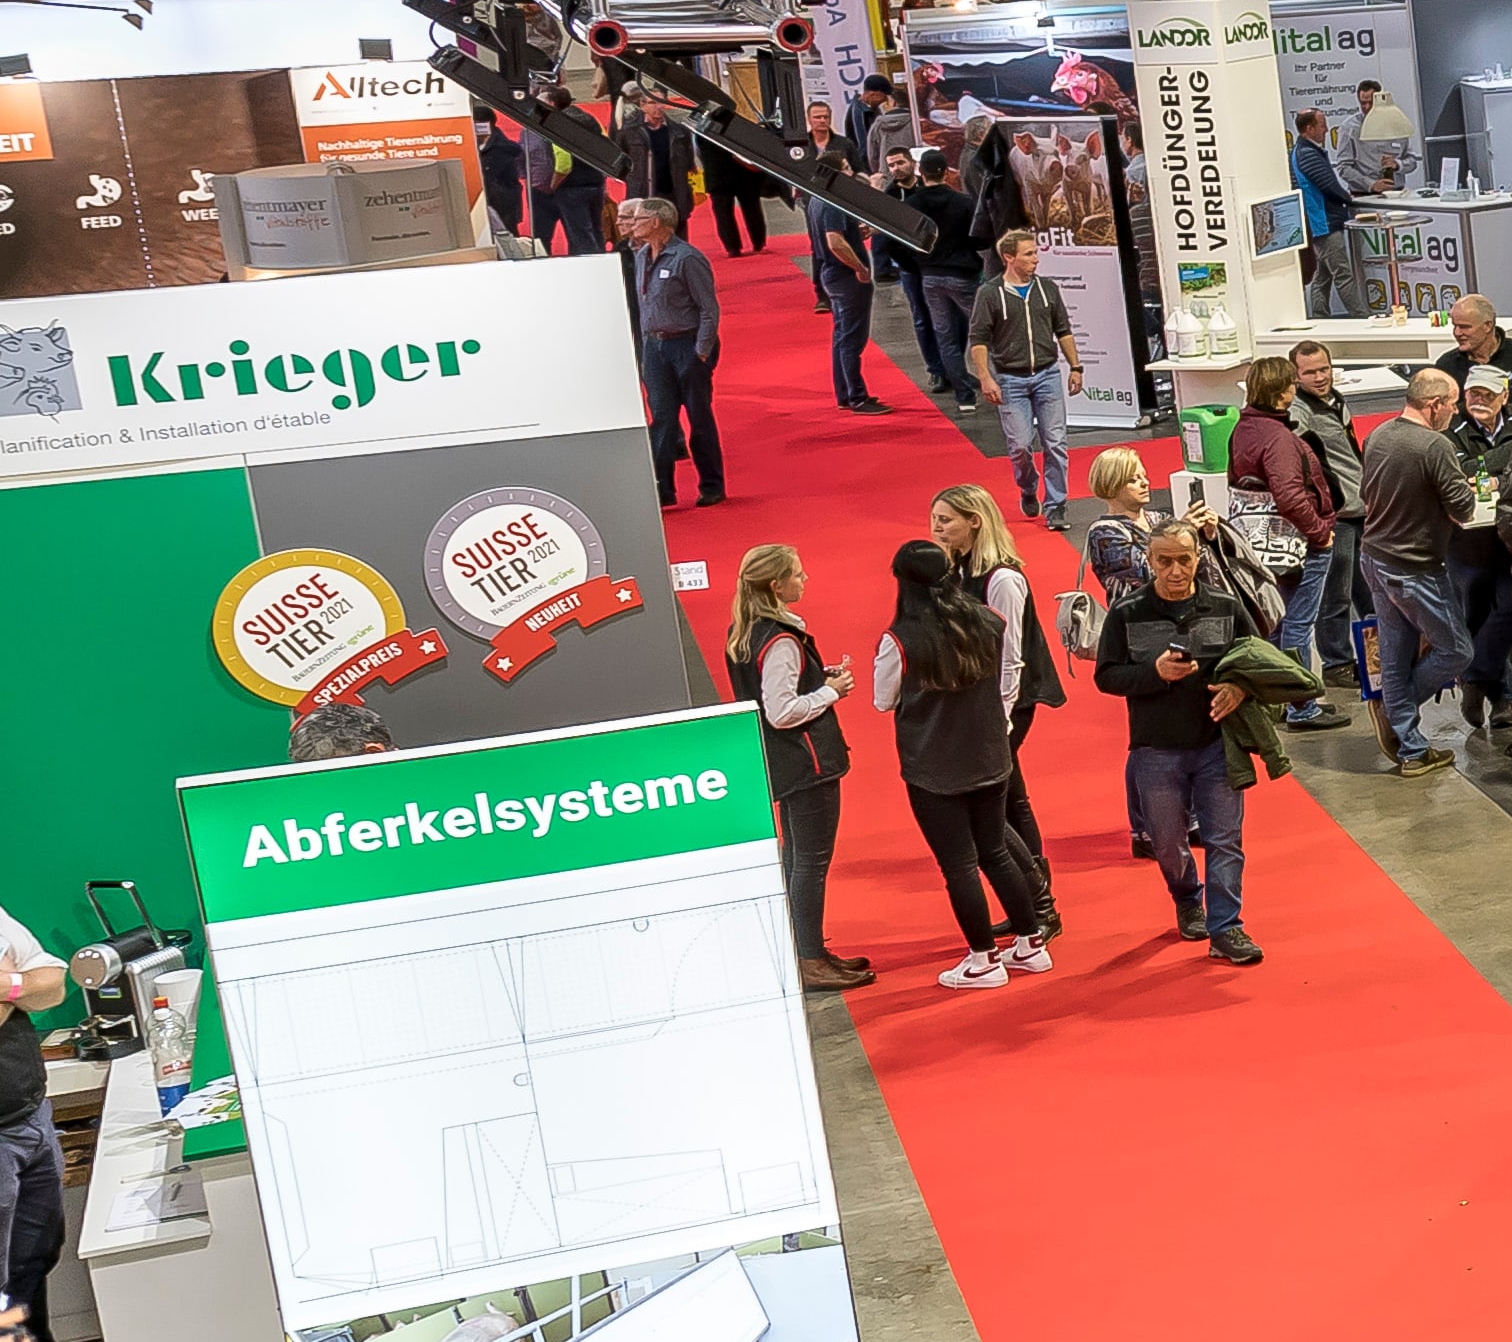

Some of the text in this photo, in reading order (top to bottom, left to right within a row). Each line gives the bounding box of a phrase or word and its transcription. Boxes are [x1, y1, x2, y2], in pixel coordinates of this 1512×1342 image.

[1138, 26, 1211, 48] LANDOR
[1224, 20, 1270, 44] LANDOR
[1337, 26, 1376, 57] ag
[1309, 61, 1346, 72] Partner
[1314, 72, 1329, 83] für
[312, 70, 446, 101] Alltech
[1314, 96, 1333, 106] und
[317, 137, 385, 152] Nachhaltige
[387, 148, 415, 159] Tiere
[416, 146, 439, 157] und
[1158, 66, 1199, 251] HOFDÜNGER-
[1189, 69, 1229, 251] VEREDELUNG
[81, 215, 122, 230] FEED
[181, 207, 220, 223] WEE
[1031, 226, 1076, 252] igFit
[1427, 234, 1459, 273] ag
[107, 339, 482, 410] Krieger
[1082, 387, 1133, 406] Vital ag
[119, 427, 134, 443] &
[139, 416, 250, 441] Installation
[452, 512, 548, 581] SUISSE
[471, 538, 561, 605] TIER 2021
[674, 565, 703, 576] Stand
[242, 573, 339, 646] SUISSE
[525, 591, 582, 634] NEUHEIT
[265, 597, 355, 670] TIER 2021
[313, 641, 404, 708] SPEZIALPREIS
[241, 766, 730, 868] Abferkelsysteme
